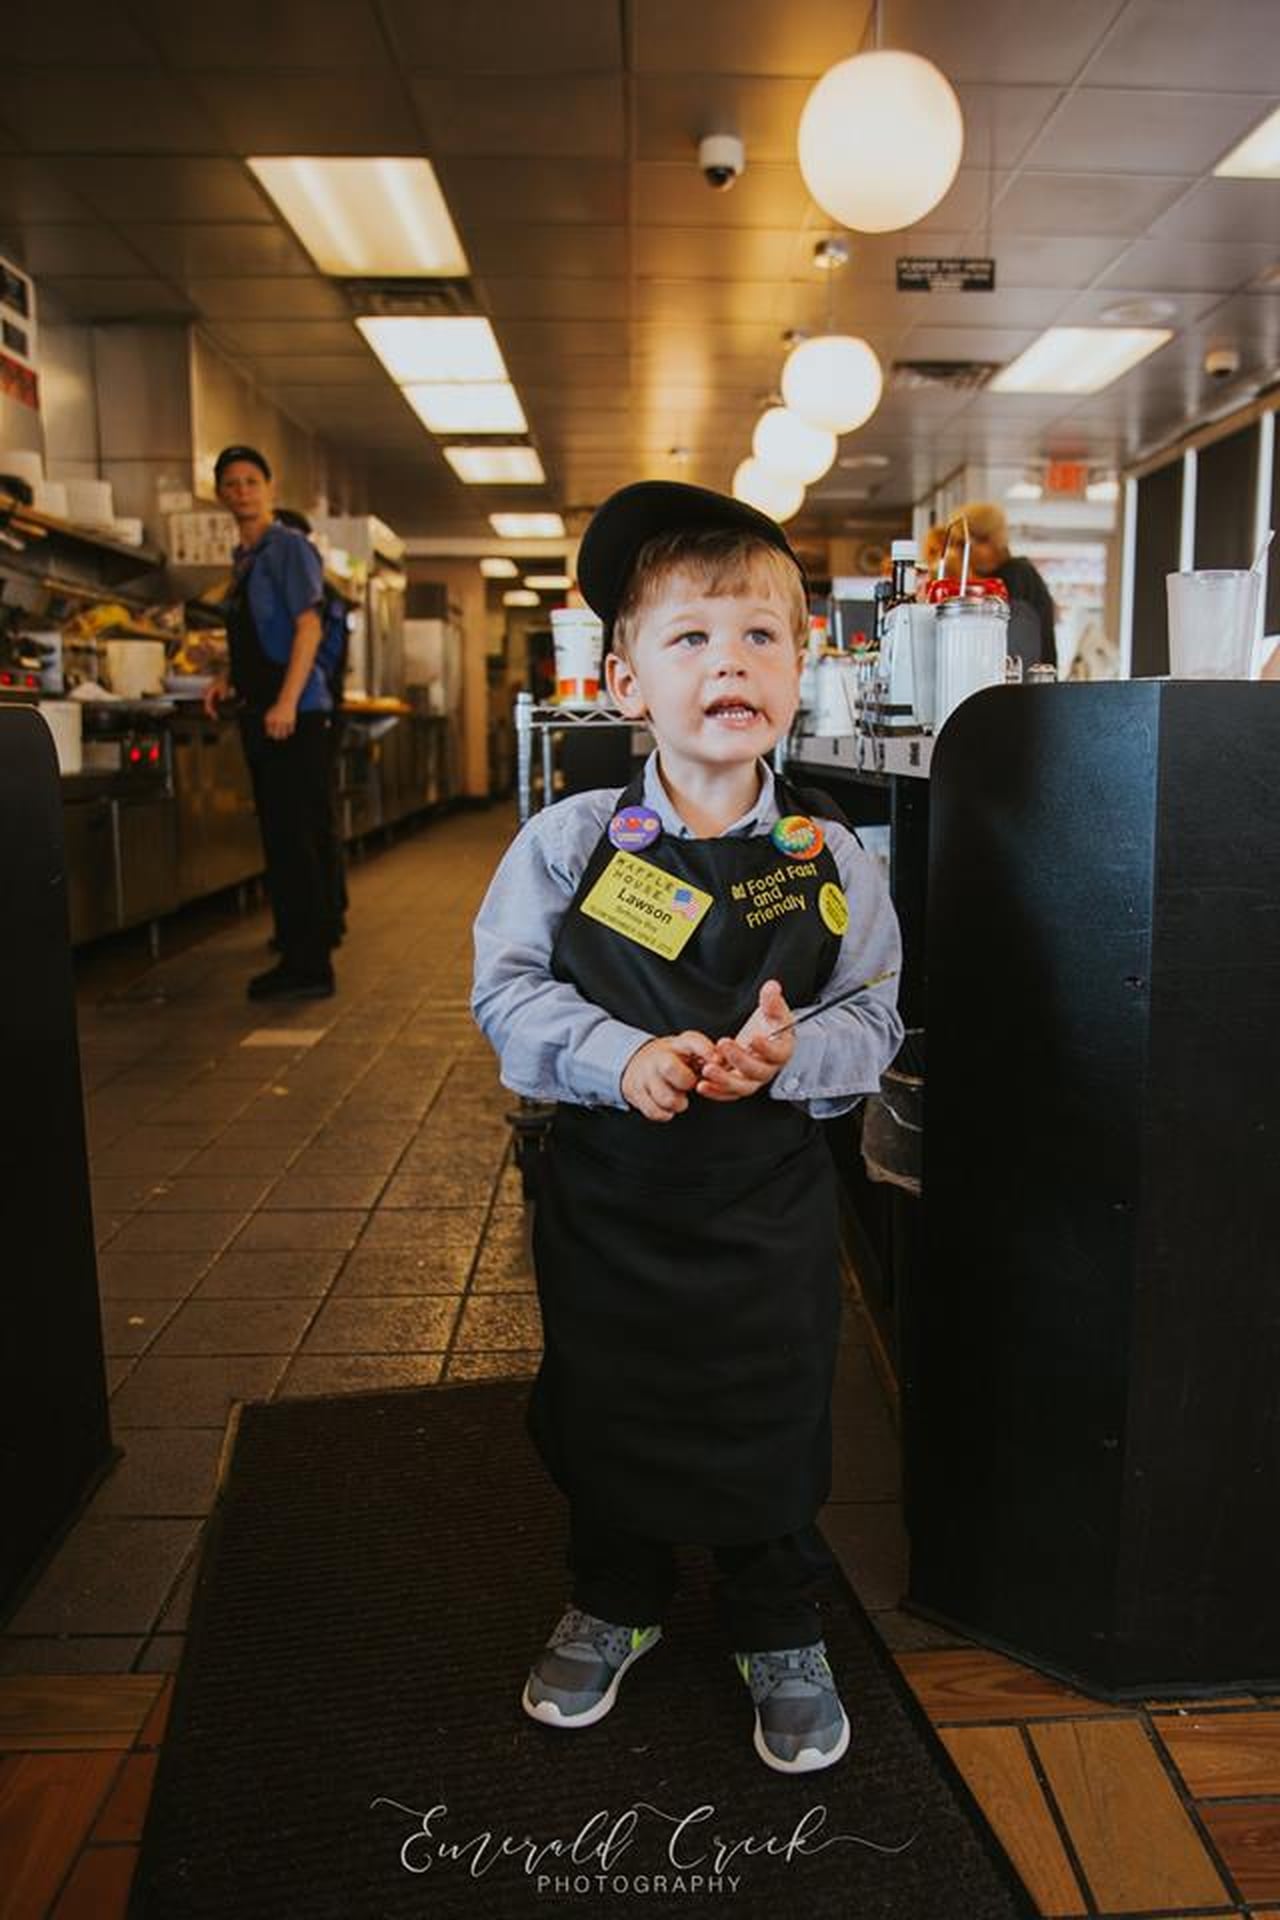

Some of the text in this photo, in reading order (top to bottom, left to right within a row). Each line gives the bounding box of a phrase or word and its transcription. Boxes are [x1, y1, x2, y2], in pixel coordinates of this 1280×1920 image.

[746, 868, 786, 896] Food
[786, 862, 818, 880] Fast
[617, 887, 673, 925] Lawson
[746, 894, 807, 929] Friendly
[753, 886, 783, 908] and
